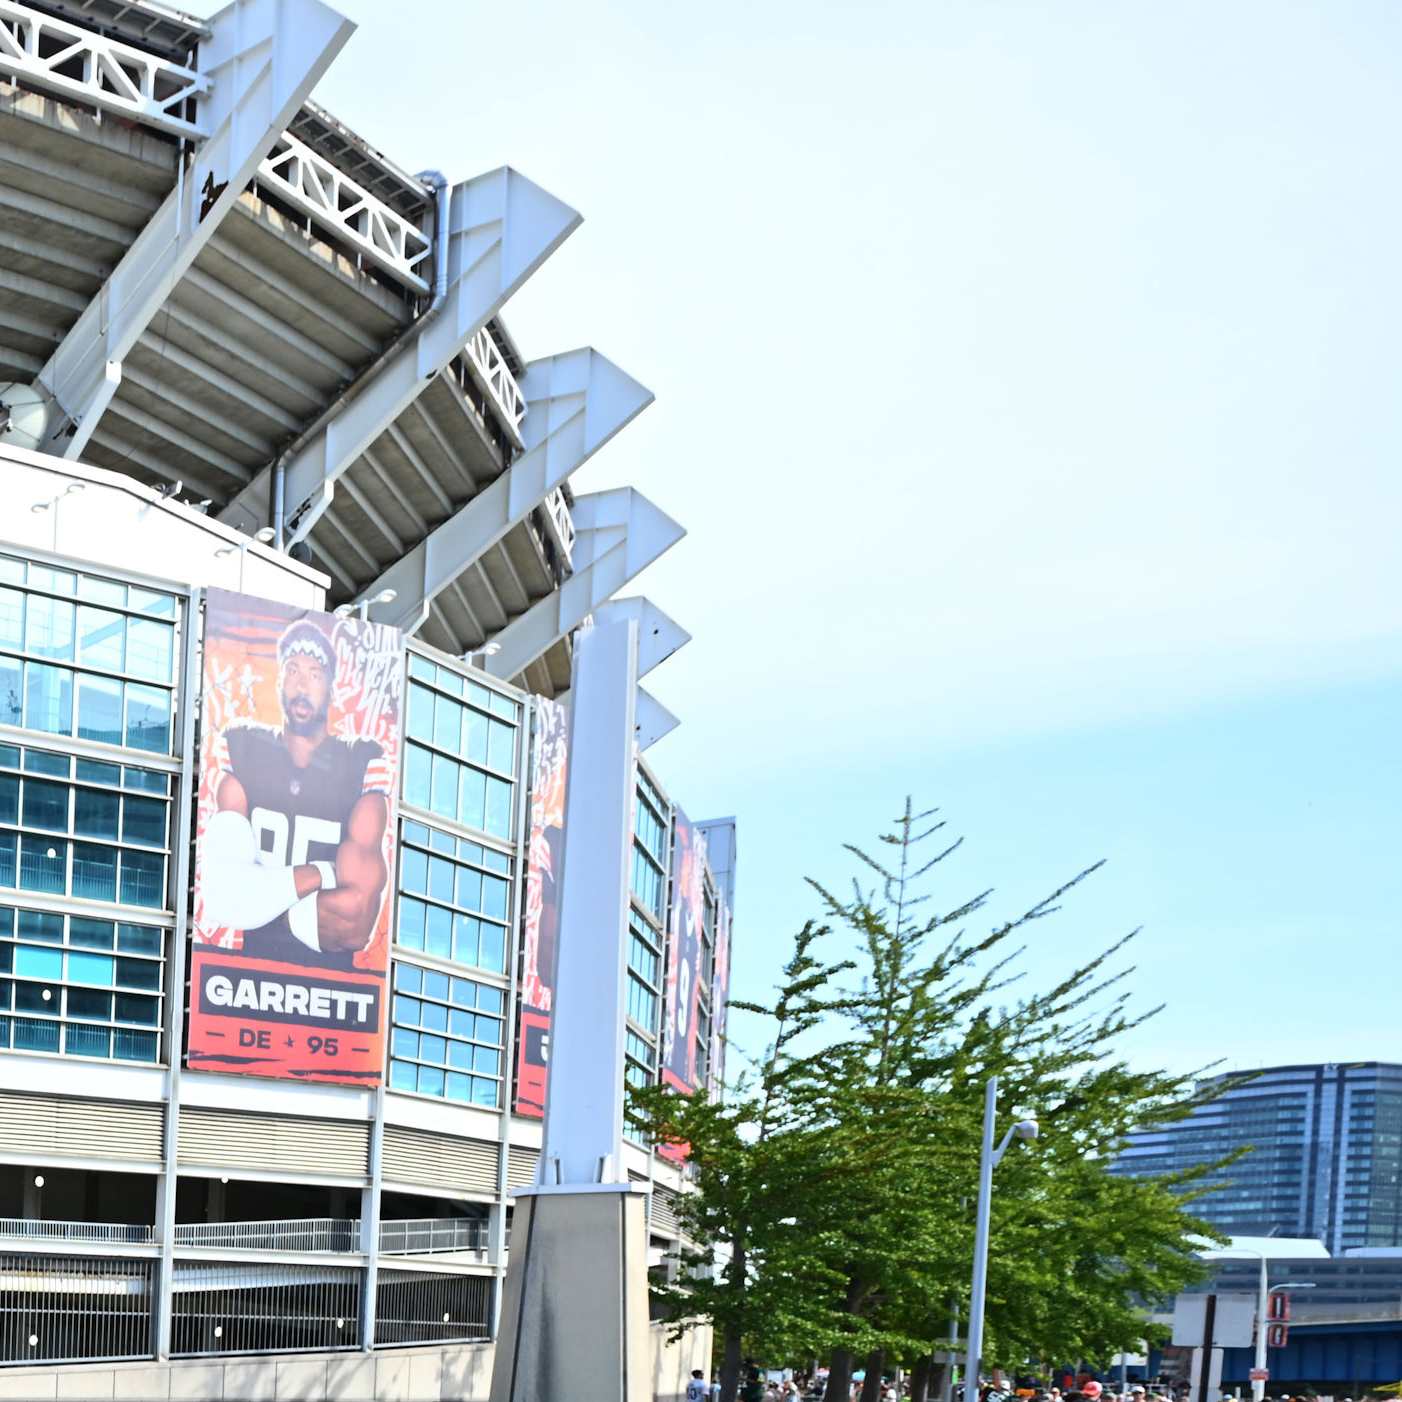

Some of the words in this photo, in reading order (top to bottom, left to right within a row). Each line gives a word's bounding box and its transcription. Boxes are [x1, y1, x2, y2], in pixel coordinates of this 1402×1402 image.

[205, 975, 374, 1025] GARRETT
[238, 1027, 271, 1050] DE
[306, 1033, 339, 1057] 95
